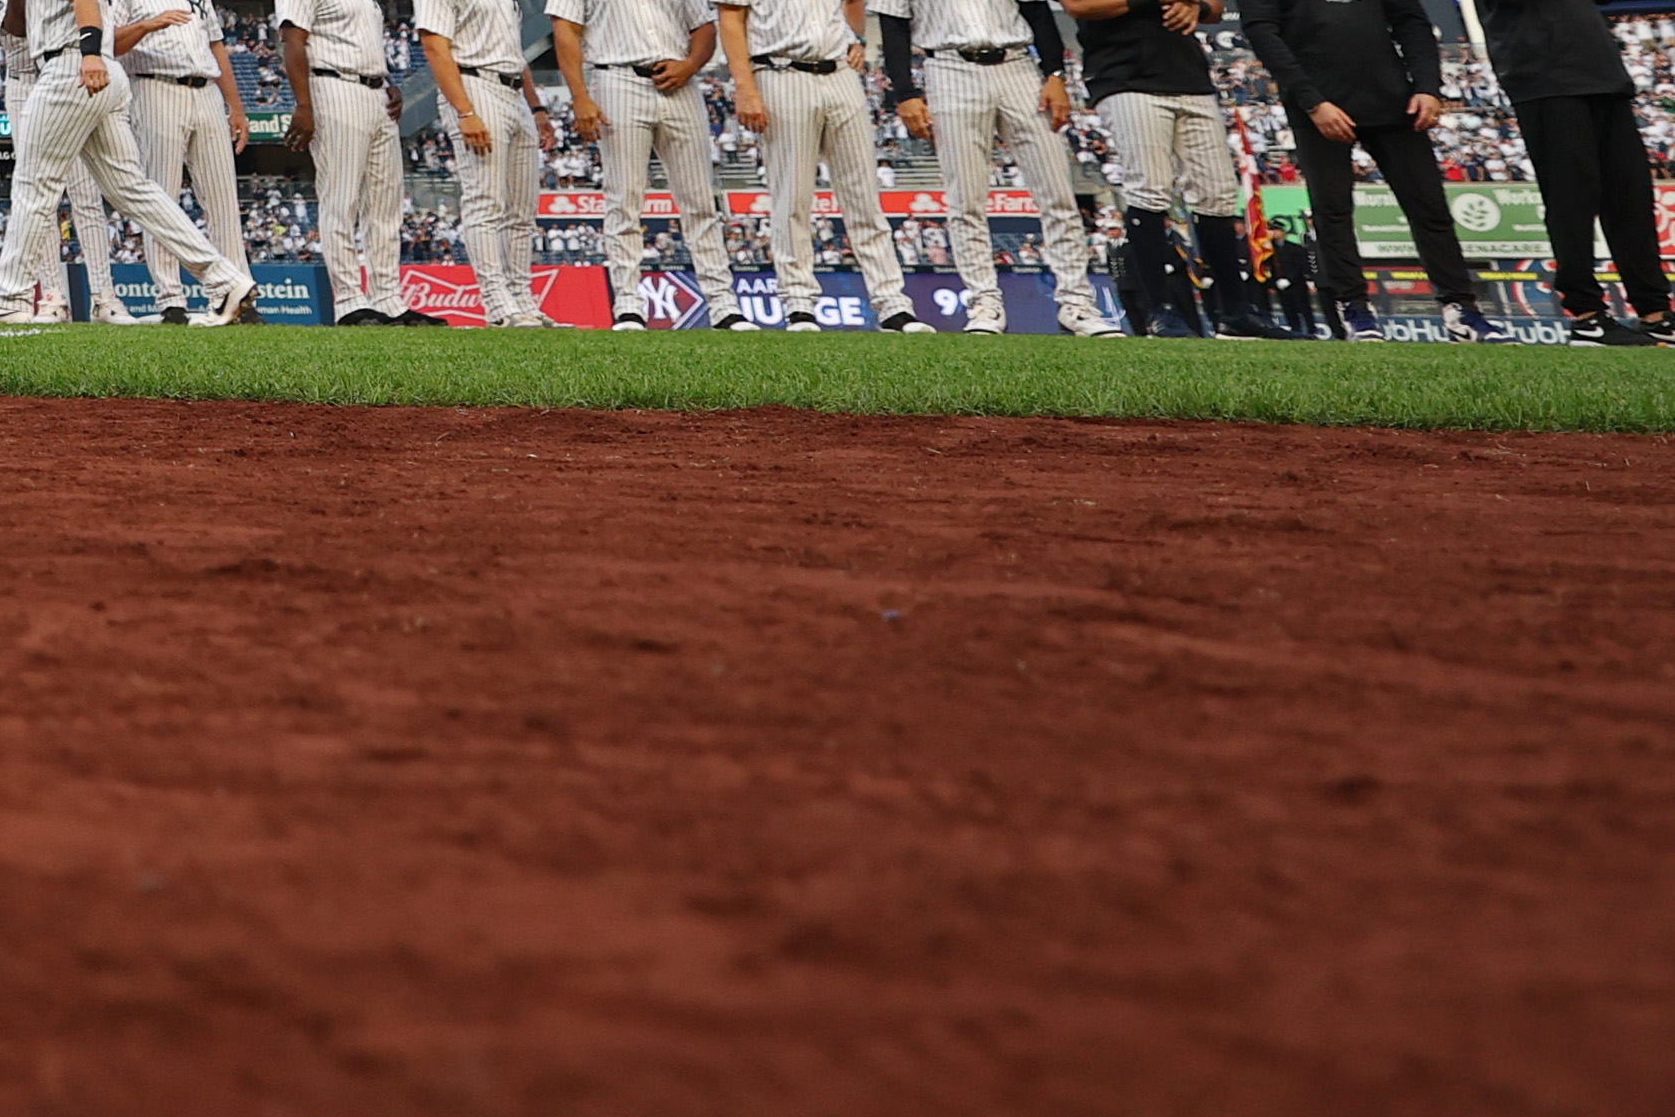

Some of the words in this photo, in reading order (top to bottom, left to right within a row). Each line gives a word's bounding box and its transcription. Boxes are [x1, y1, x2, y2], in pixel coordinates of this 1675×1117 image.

[245, 114, 280, 133] and
[578, 195, 606, 213] Sta
[644, 199, 672, 213] rm
[114, 282, 210, 298] onteore
[258, 278, 310, 299] stein
[736, 278, 777, 294] AAR
[638, 277, 681, 321] NY
[256, 306, 281, 314] uman
[282, 305, 313, 315] Health
[739, 295, 865, 326] JUGE
[1382, 319, 1450, 342] ubHu
